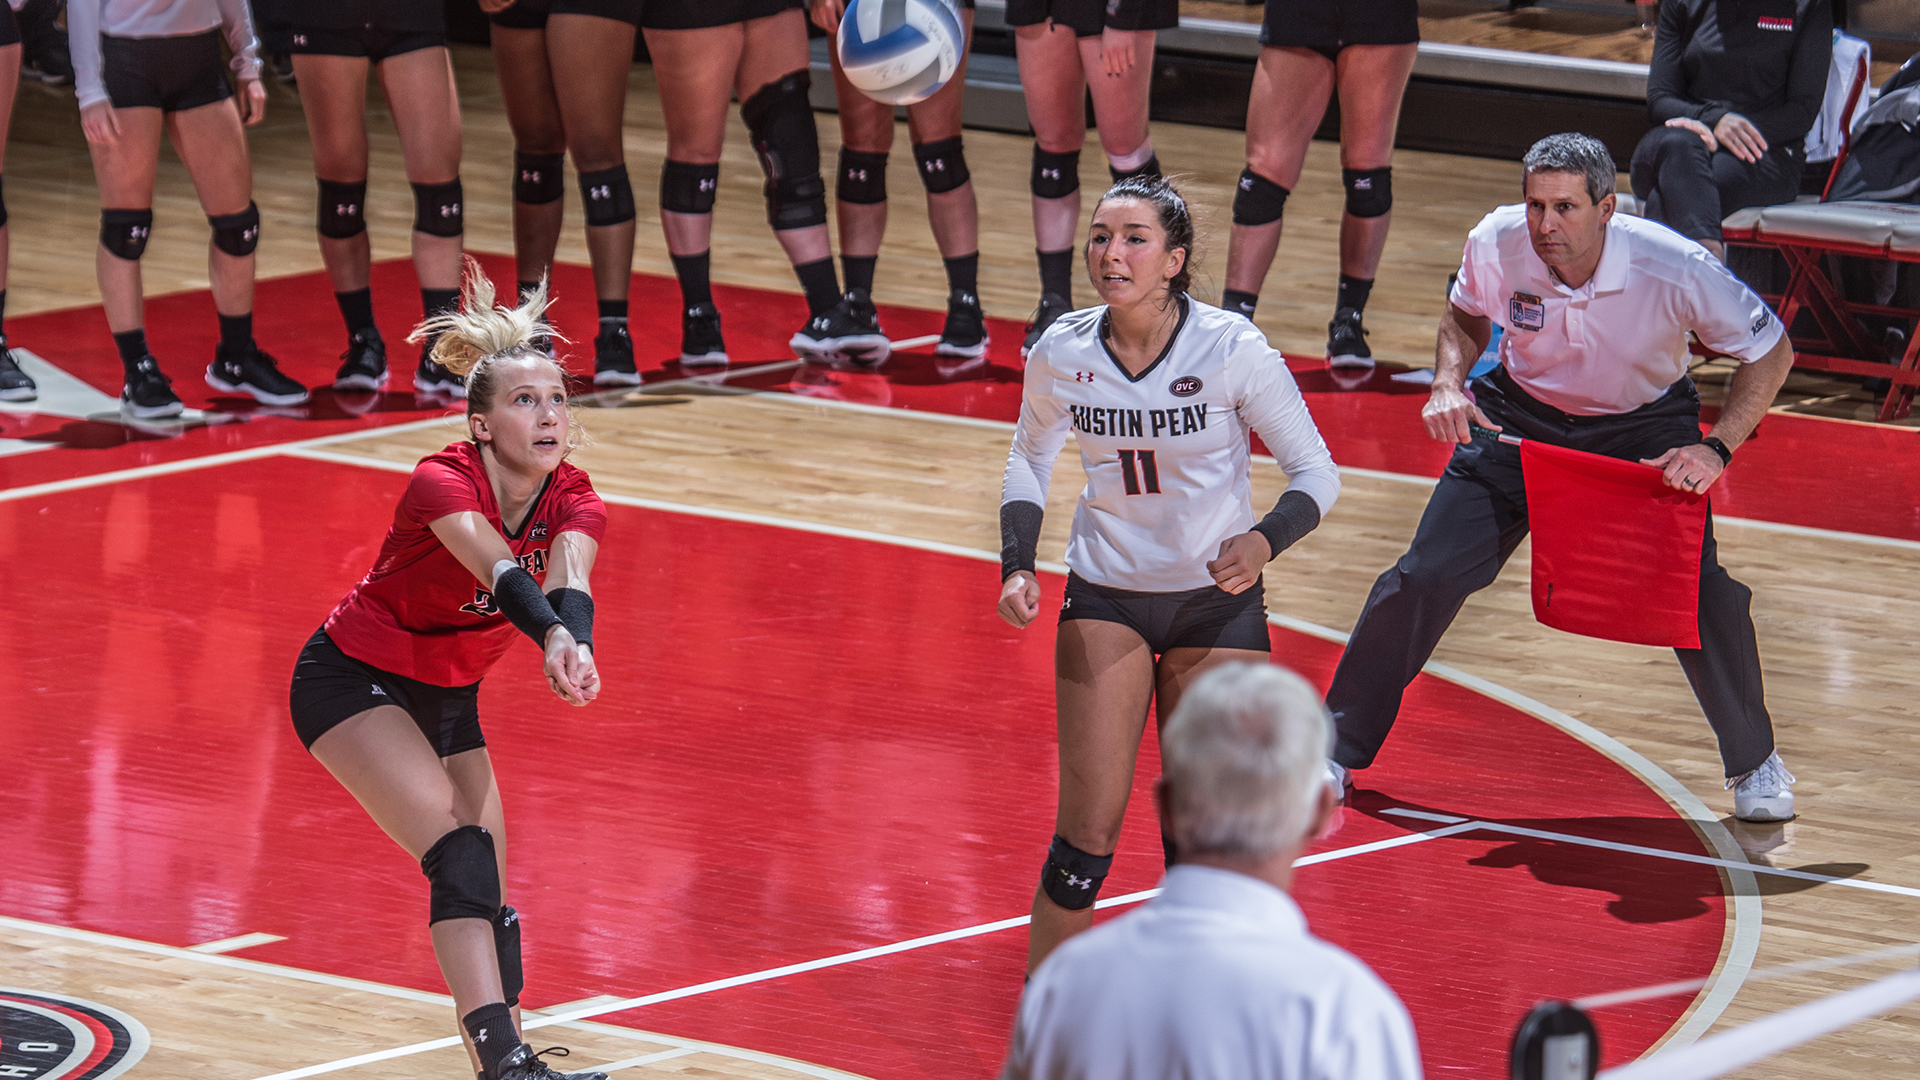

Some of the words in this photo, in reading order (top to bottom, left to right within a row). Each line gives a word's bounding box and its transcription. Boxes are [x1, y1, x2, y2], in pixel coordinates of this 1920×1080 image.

[1176, 382, 1195, 391] OVC
[1070, 404, 1143, 437] AUSTIN
[1149, 403, 1207, 438] PEAY
[1117, 448, 1161, 496] 11
[514, 549, 547, 575] EA
